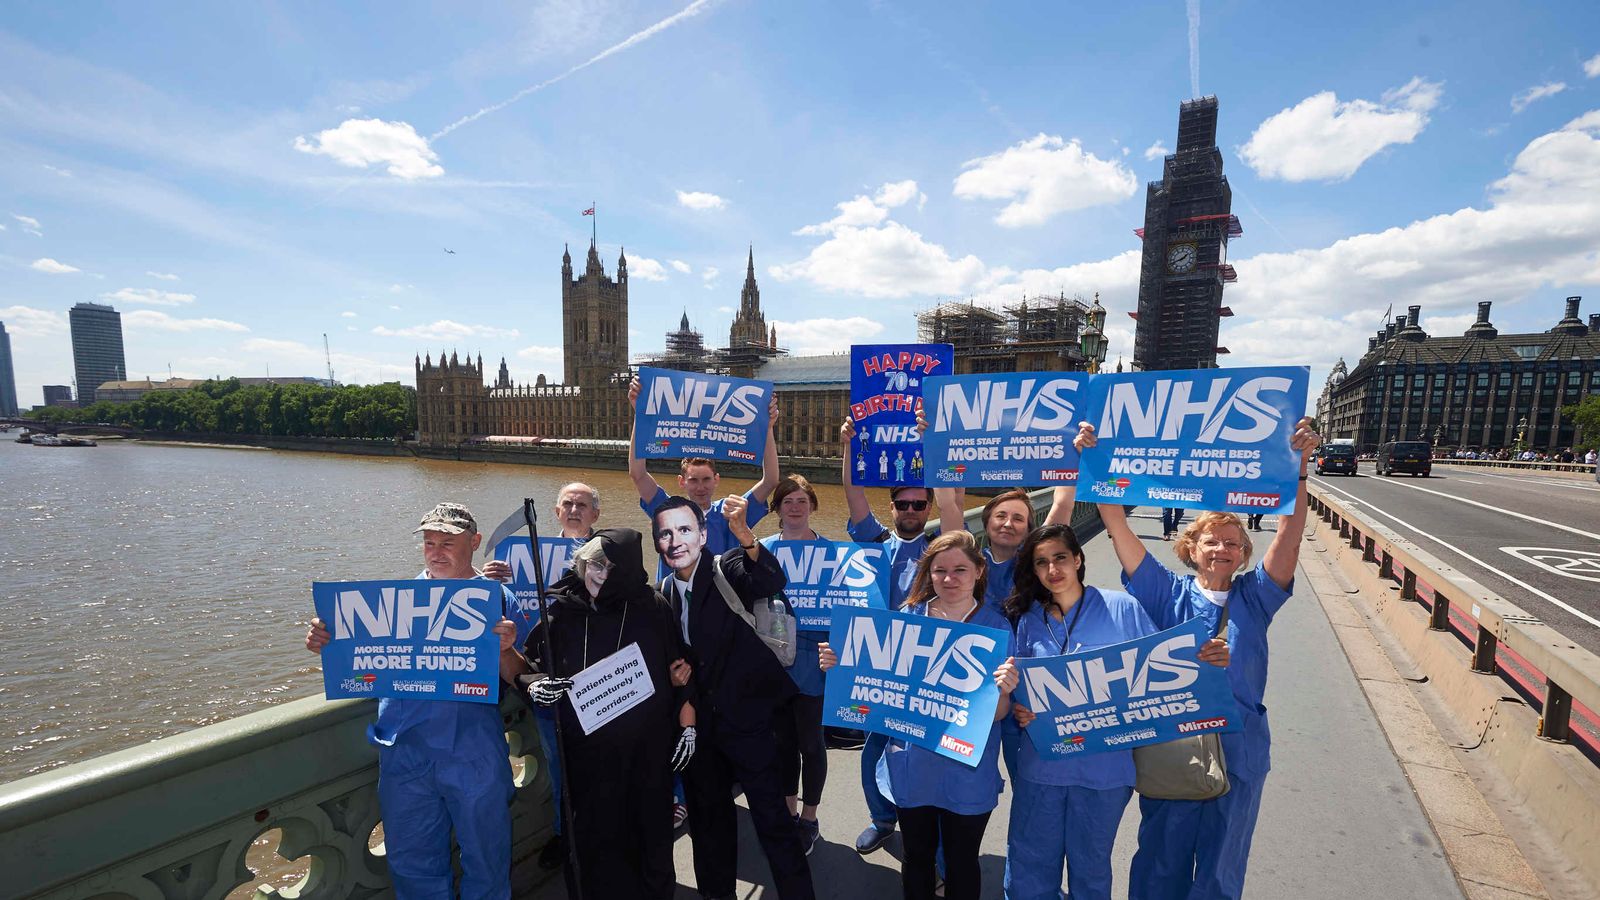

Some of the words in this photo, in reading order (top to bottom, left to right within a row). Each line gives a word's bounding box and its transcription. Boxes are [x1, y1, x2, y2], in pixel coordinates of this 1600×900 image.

[863, 352, 941, 376] HAPPY
[885, 372, 918, 391] 70th
[645, 376, 764, 426] NHS
[934, 379, 1079, 432] NHS
[1098, 377, 1293, 443] NHS
[655, 427, 697, 439] MORE
[701, 430, 746, 444] FUNDS
[875, 426, 920, 442] NHS
[950, 438, 974, 446] MORE
[1010, 436, 1037, 444] MORE
[728, 450, 756, 460] Mirror
[947, 447, 999, 461] MORE
[1003, 445, 1064, 460] FUNDS
[1114, 447, 1145, 456] MORE
[1148, 449, 1179, 458] STAFF
[1190, 449, 1226, 458] MORE
[1229, 450, 1260, 459] BEDS
[1041, 470, 1079, 480] Mirror
[1108, 458, 1174, 476] MORE
[1180, 460, 1261, 479] FUNDS
[1148, 491, 1202, 502] TOGETHER
[1227, 493, 1279, 506] Mirror
[774, 546, 882, 588] NHS
[788, 596, 816, 608] ORE
[335, 587, 490, 641] NHS
[354, 646, 385, 654] MORE
[386, 646, 413, 654] STAFF
[423, 646, 451, 654] MORE
[840, 616, 996, 693] NHS
[353, 656, 411, 671] MORE
[416, 657, 477, 672] FUNDS
[1023, 634, 1200, 713] NHS
[393, 684, 436, 692] TOGETHER
[575, 671, 612, 699] patients
[614, 658, 639, 677] dying
[454, 684, 487, 695] Mirror
[580, 675, 633, 712] prematurely
[635, 670, 644, 679] in
[854, 676, 883, 687] MORE
[883, 680, 909, 692] STAFF
[918, 688, 944, 702] MORE
[946, 694, 969, 708] BEDS
[596, 690, 638, 716] corridors.
[850, 686, 905, 709] MORE
[909, 696, 969, 727] FUNDS
[1055, 711, 1086, 724] MORE
[1087, 706, 1117, 717] STAFF
[1128, 697, 1162, 710] MORE
[1163, 692, 1194, 702] BEDS
[1057, 716, 1120, 736] MORE
[1122, 700, 1200, 724] FUNDS
[1178, 719, 1226, 733] Mirror
[884, 720, 925, 739] TOGETHER
[1104, 731, 1157, 746] TOGETHER
[941, 734, 973, 756] Mirror
